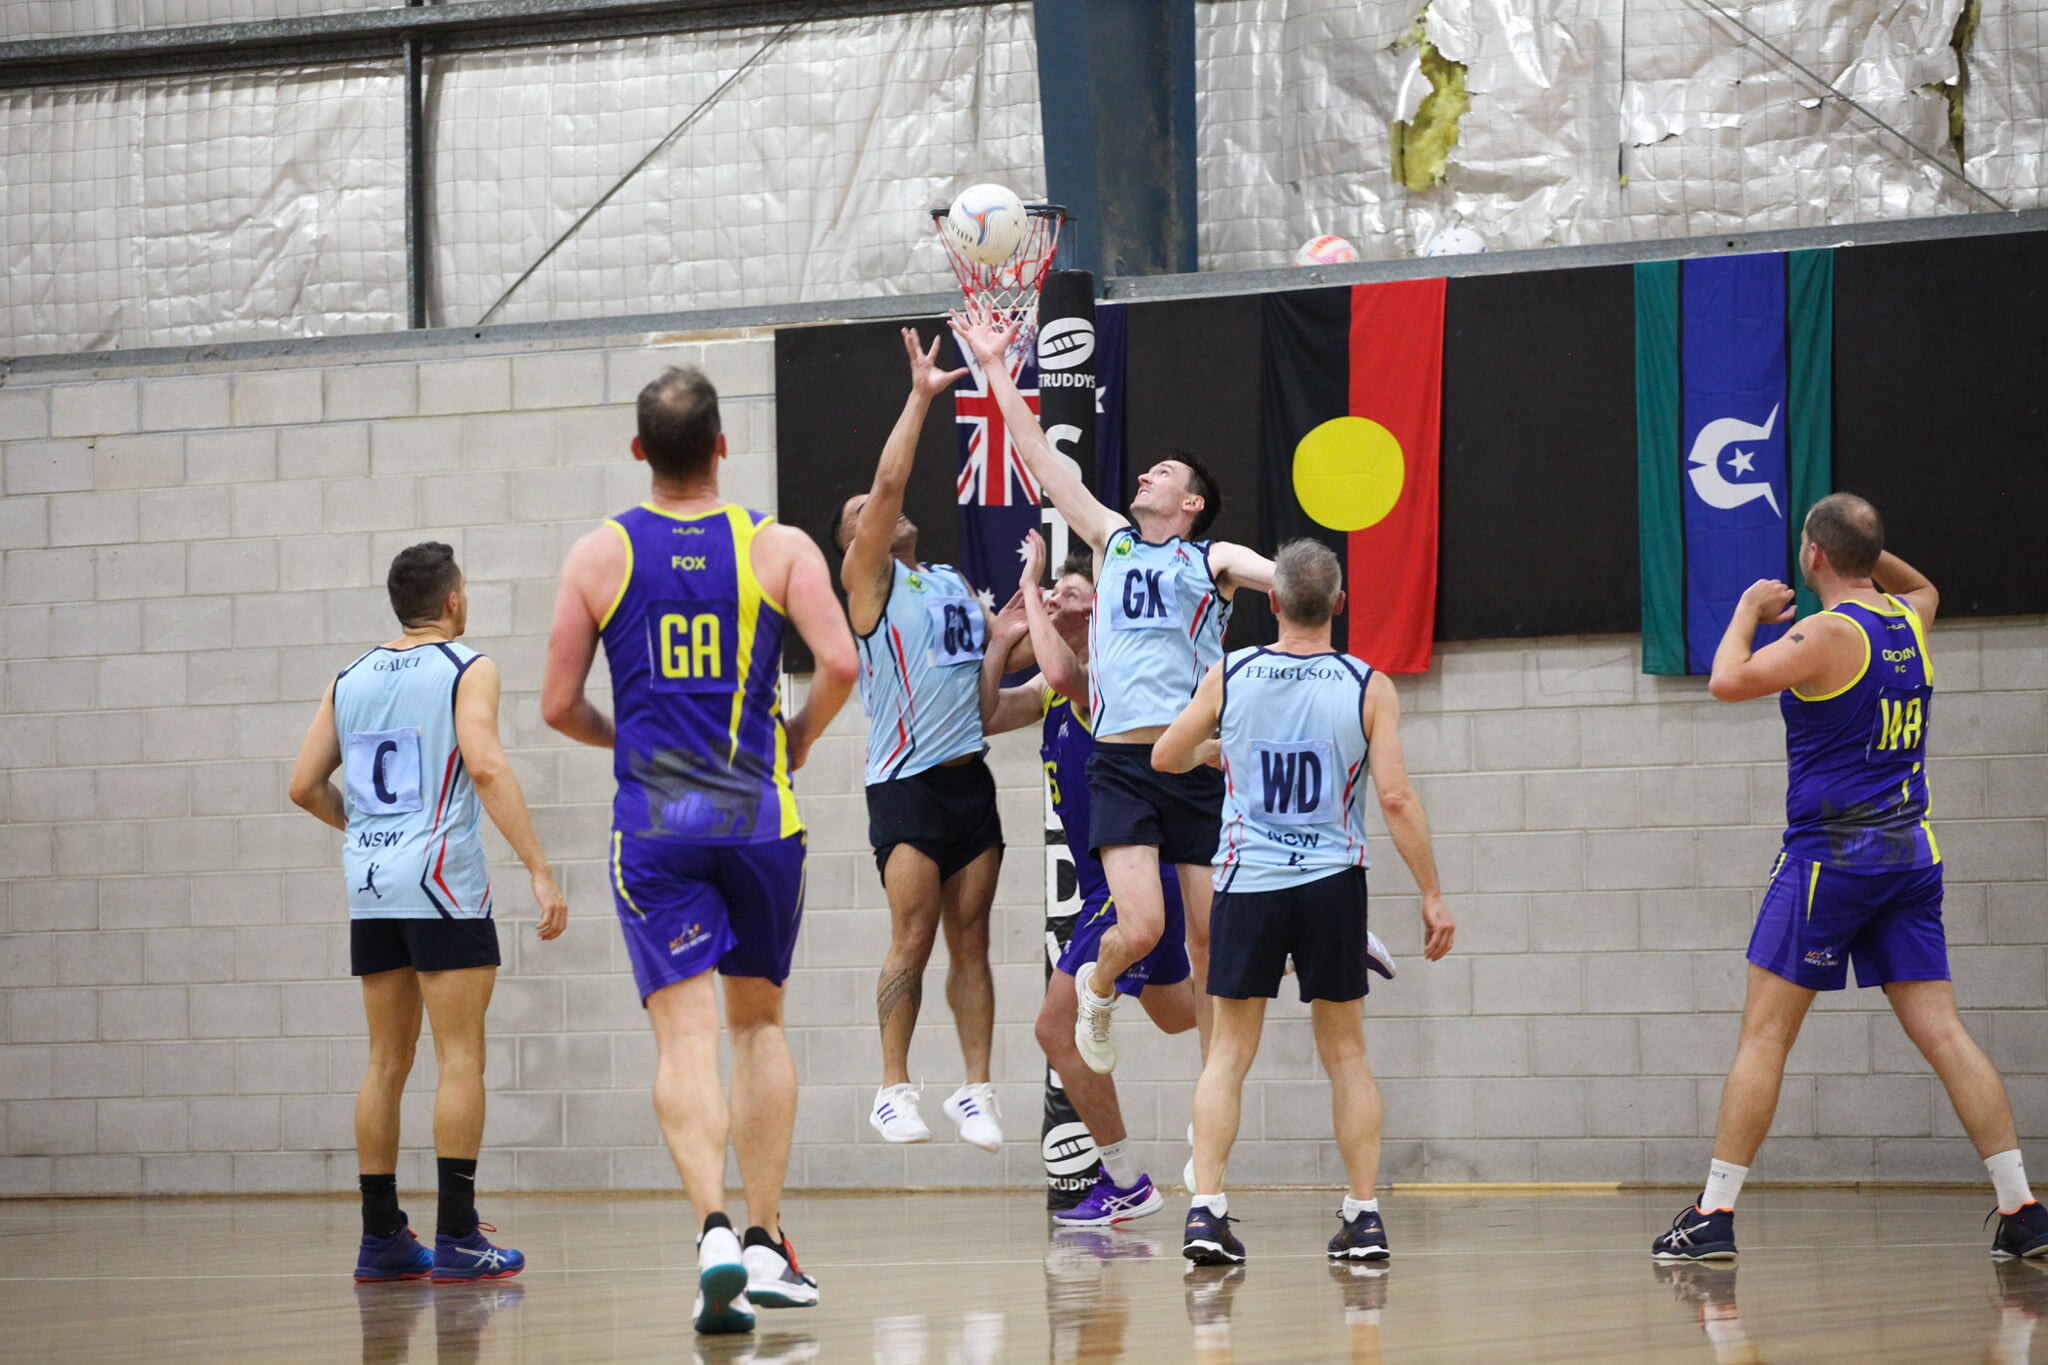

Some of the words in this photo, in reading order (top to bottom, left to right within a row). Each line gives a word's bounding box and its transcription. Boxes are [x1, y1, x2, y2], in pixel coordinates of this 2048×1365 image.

[671, 555, 706, 570] FOX
[1122, 568, 1168, 619] GK
[373, 657, 421, 672] GAUCI
[659, 613, 722, 679] GA
[1245, 666, 1345, 682] FERGUSON
[1876, 697, 1923, 751] WA
[372, 740, 397, 805] C
[1261, 750, 1322, 815] WD
[358, 831, 404, 849] NSW
